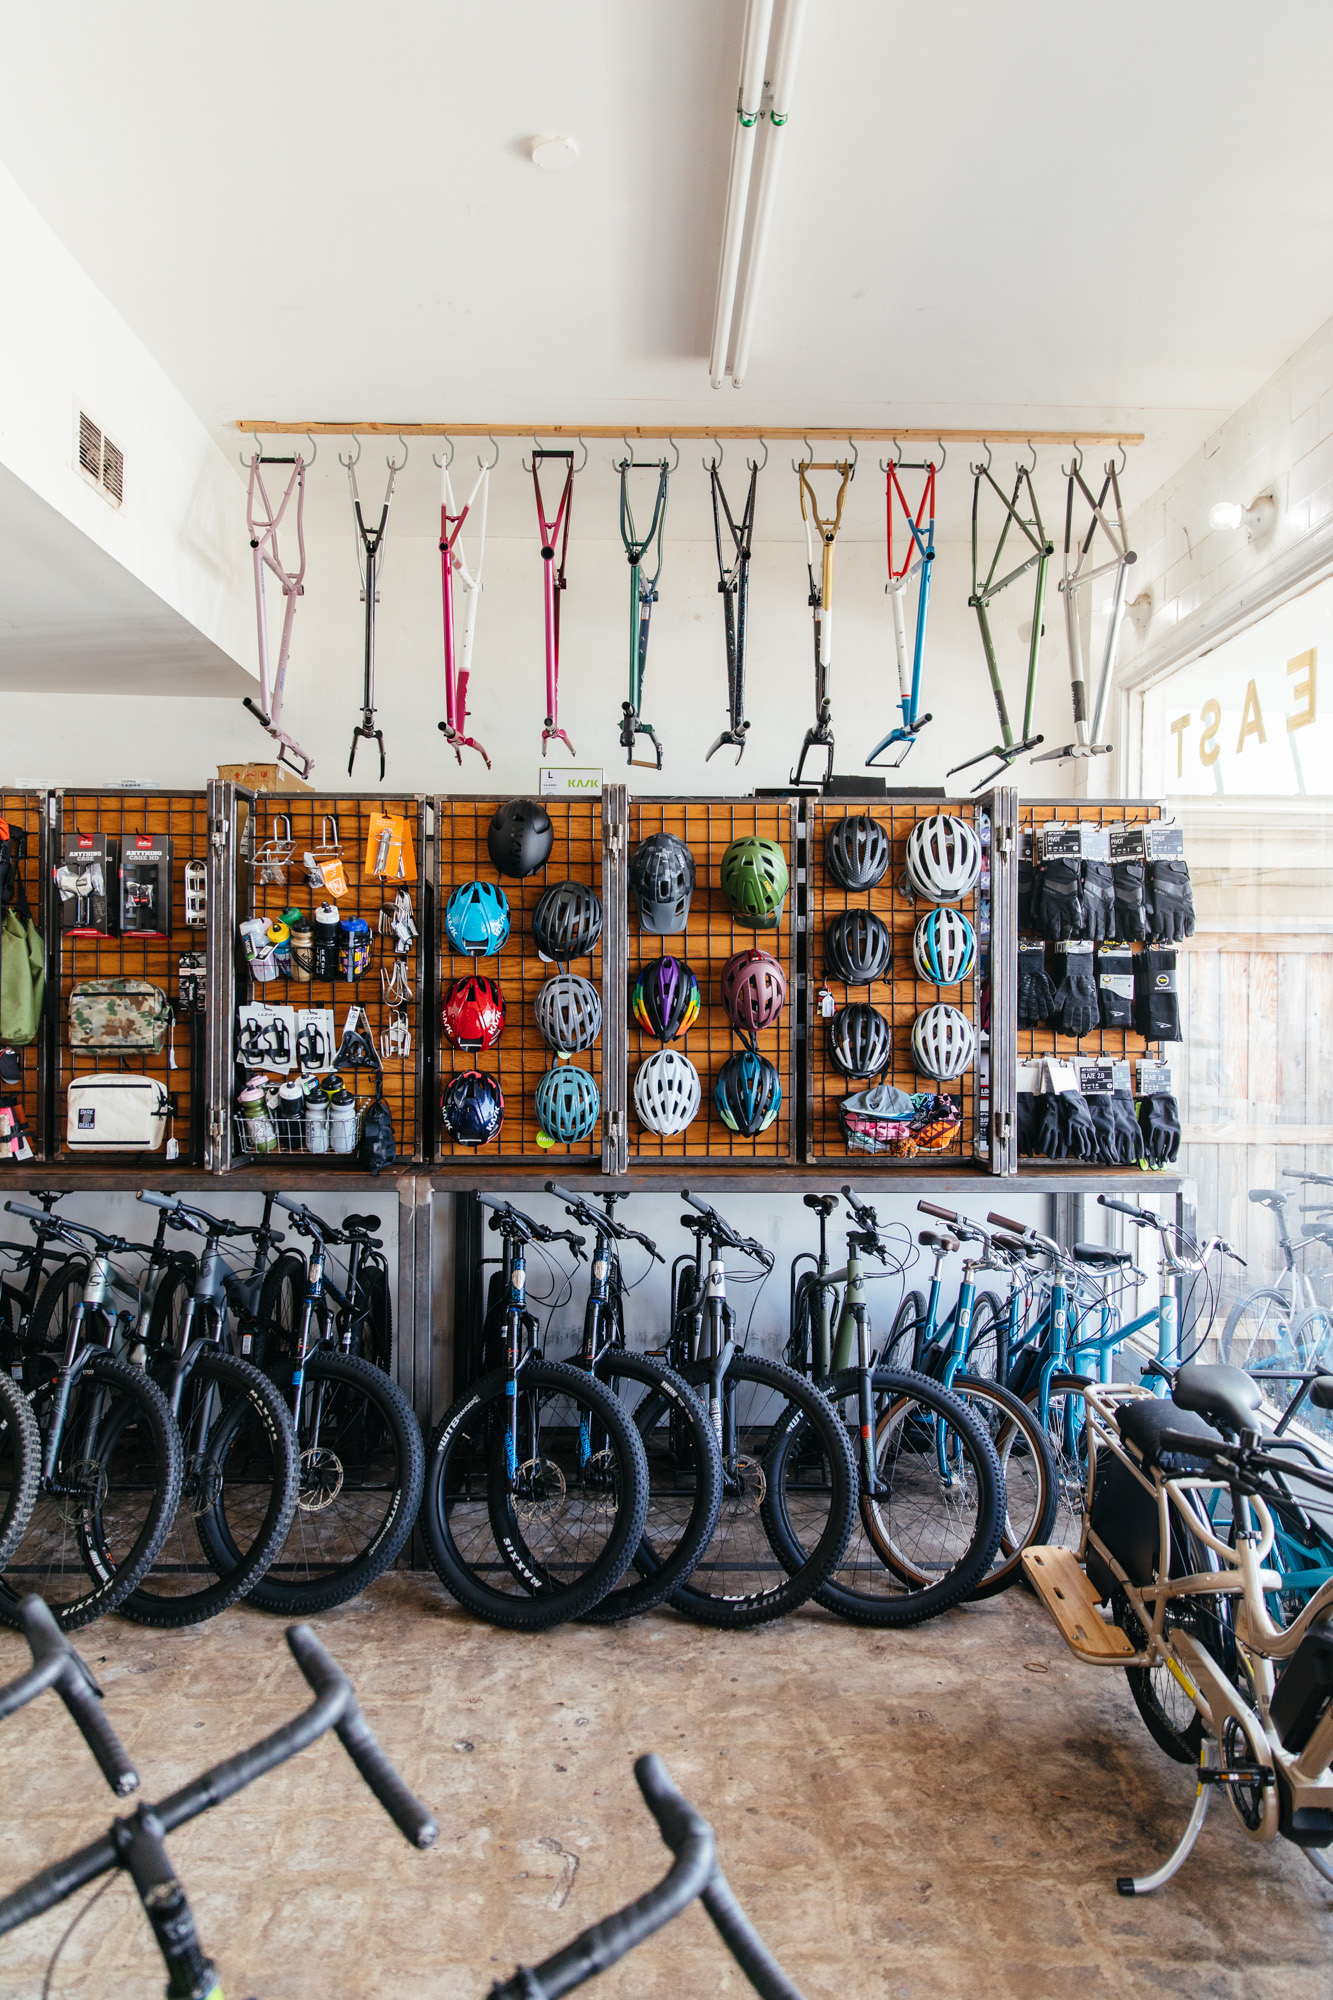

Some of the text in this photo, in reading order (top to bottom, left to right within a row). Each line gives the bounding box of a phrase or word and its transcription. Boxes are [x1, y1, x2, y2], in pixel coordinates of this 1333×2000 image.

[568, 779, 598, 788] KASK
[442, 1010, 454, 1035] KASK
[488, 1010, 501, 1035] KASK
[441, 1105, 453, 1130] KASK
[486, 1105, 500, 1131] KASK
[250, 1389, 278, 1440] MAXXIS
[503, 1537, 542, 1588] MAXXIS
